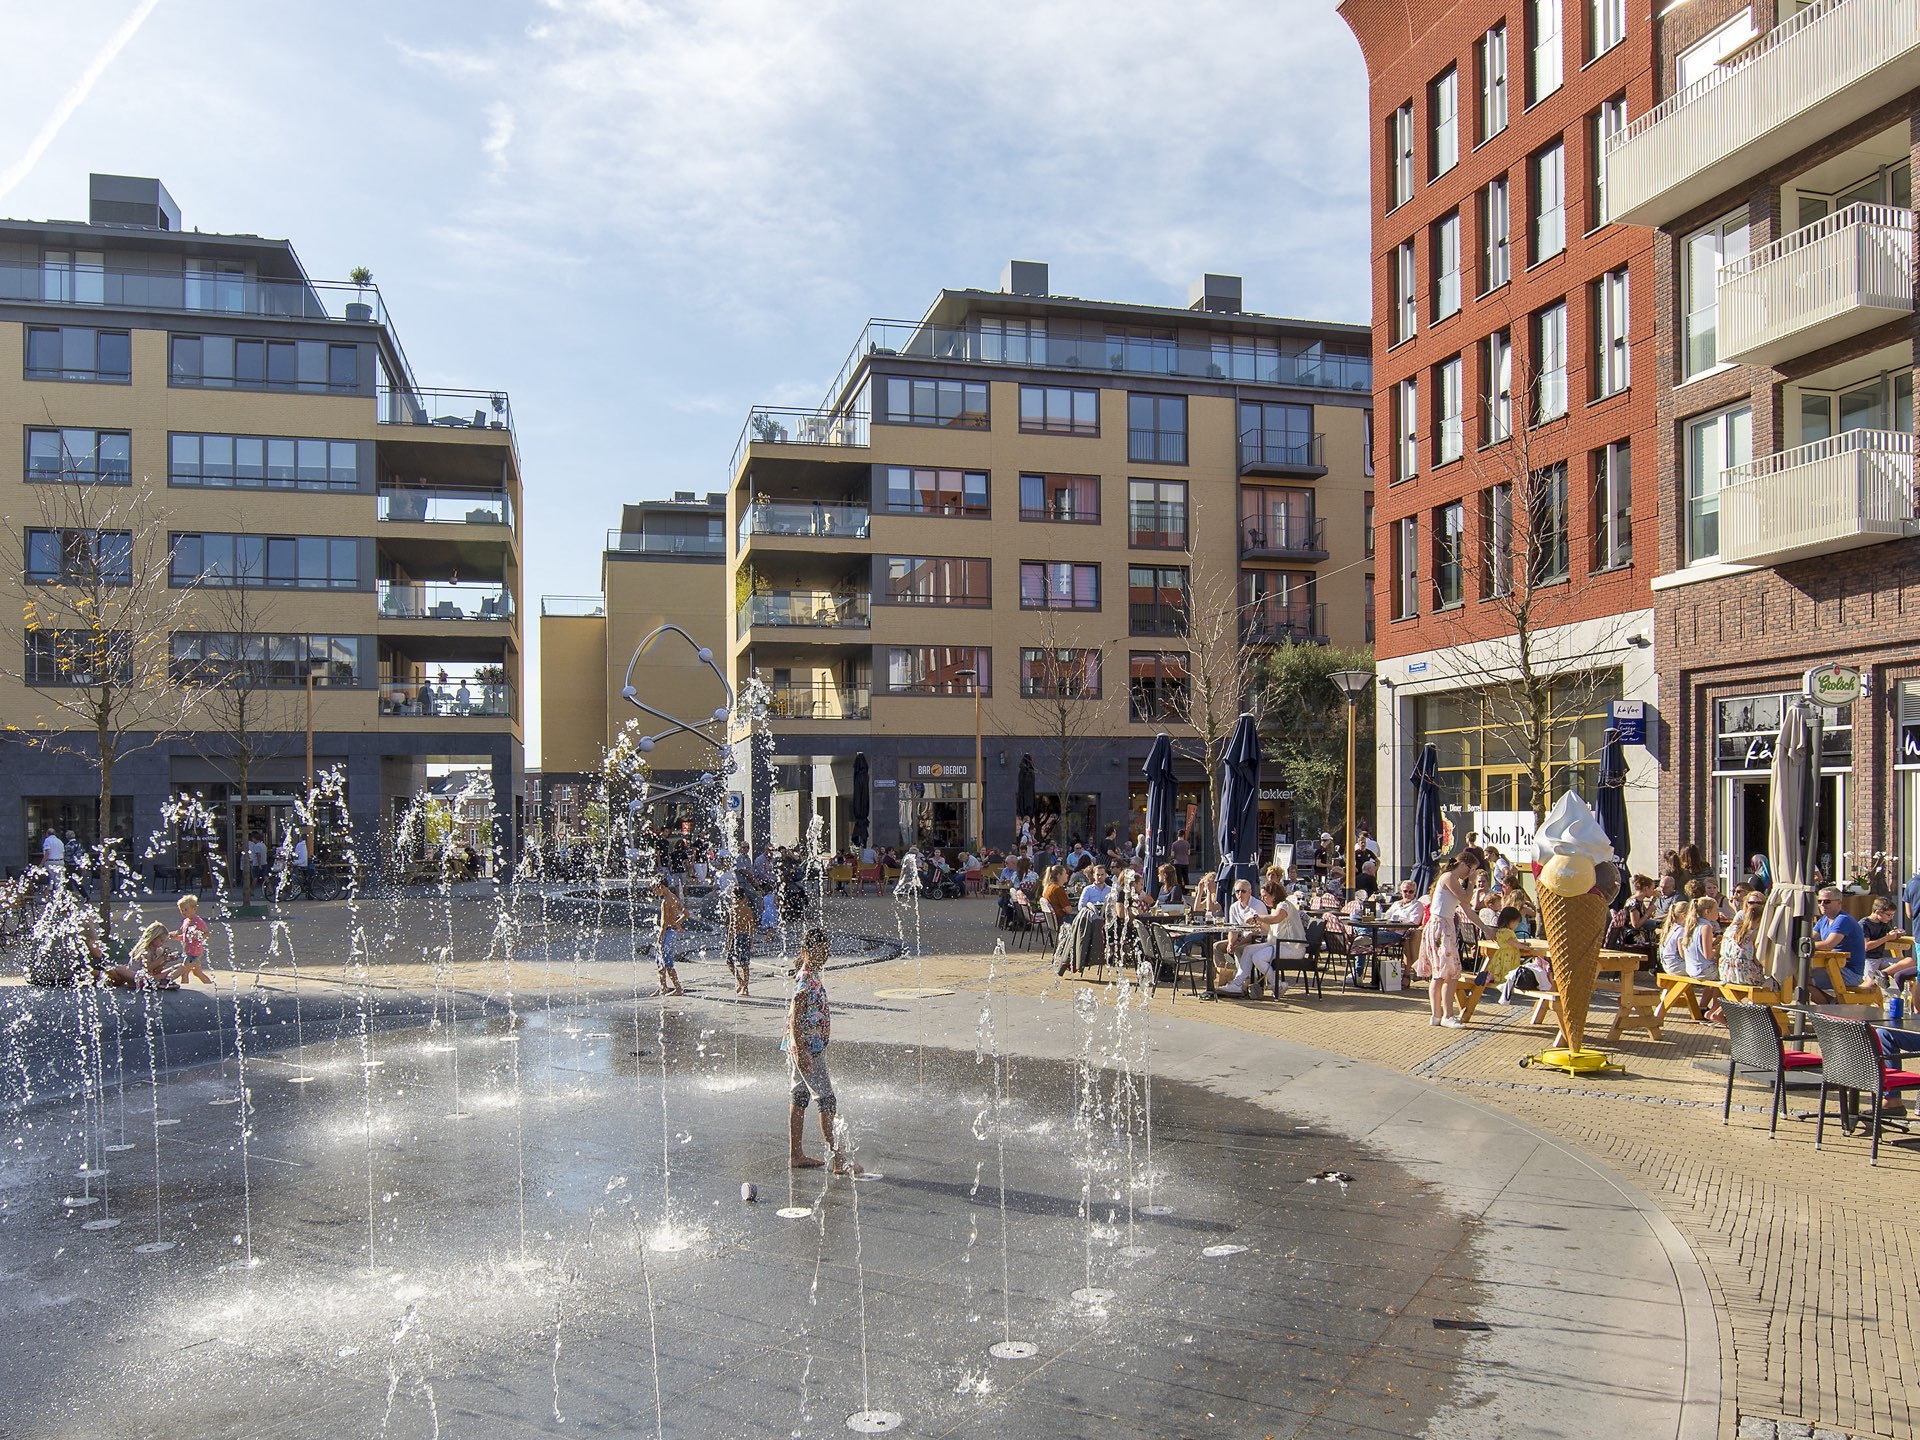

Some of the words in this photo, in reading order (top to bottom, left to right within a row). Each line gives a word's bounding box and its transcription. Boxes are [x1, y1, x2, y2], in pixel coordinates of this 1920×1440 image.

[1818, 675, 1856, 693] Grolsch
[918, 765, 931, 775] BAR
[943, 765, 967, 775] IBERICO
[1258, 788, 1295, 800] lokker
[1449, 803, 1462, 812] Diner
[1482, 825, 1510, 845] Solo
[1515, 825, 1534, 845] Pas
